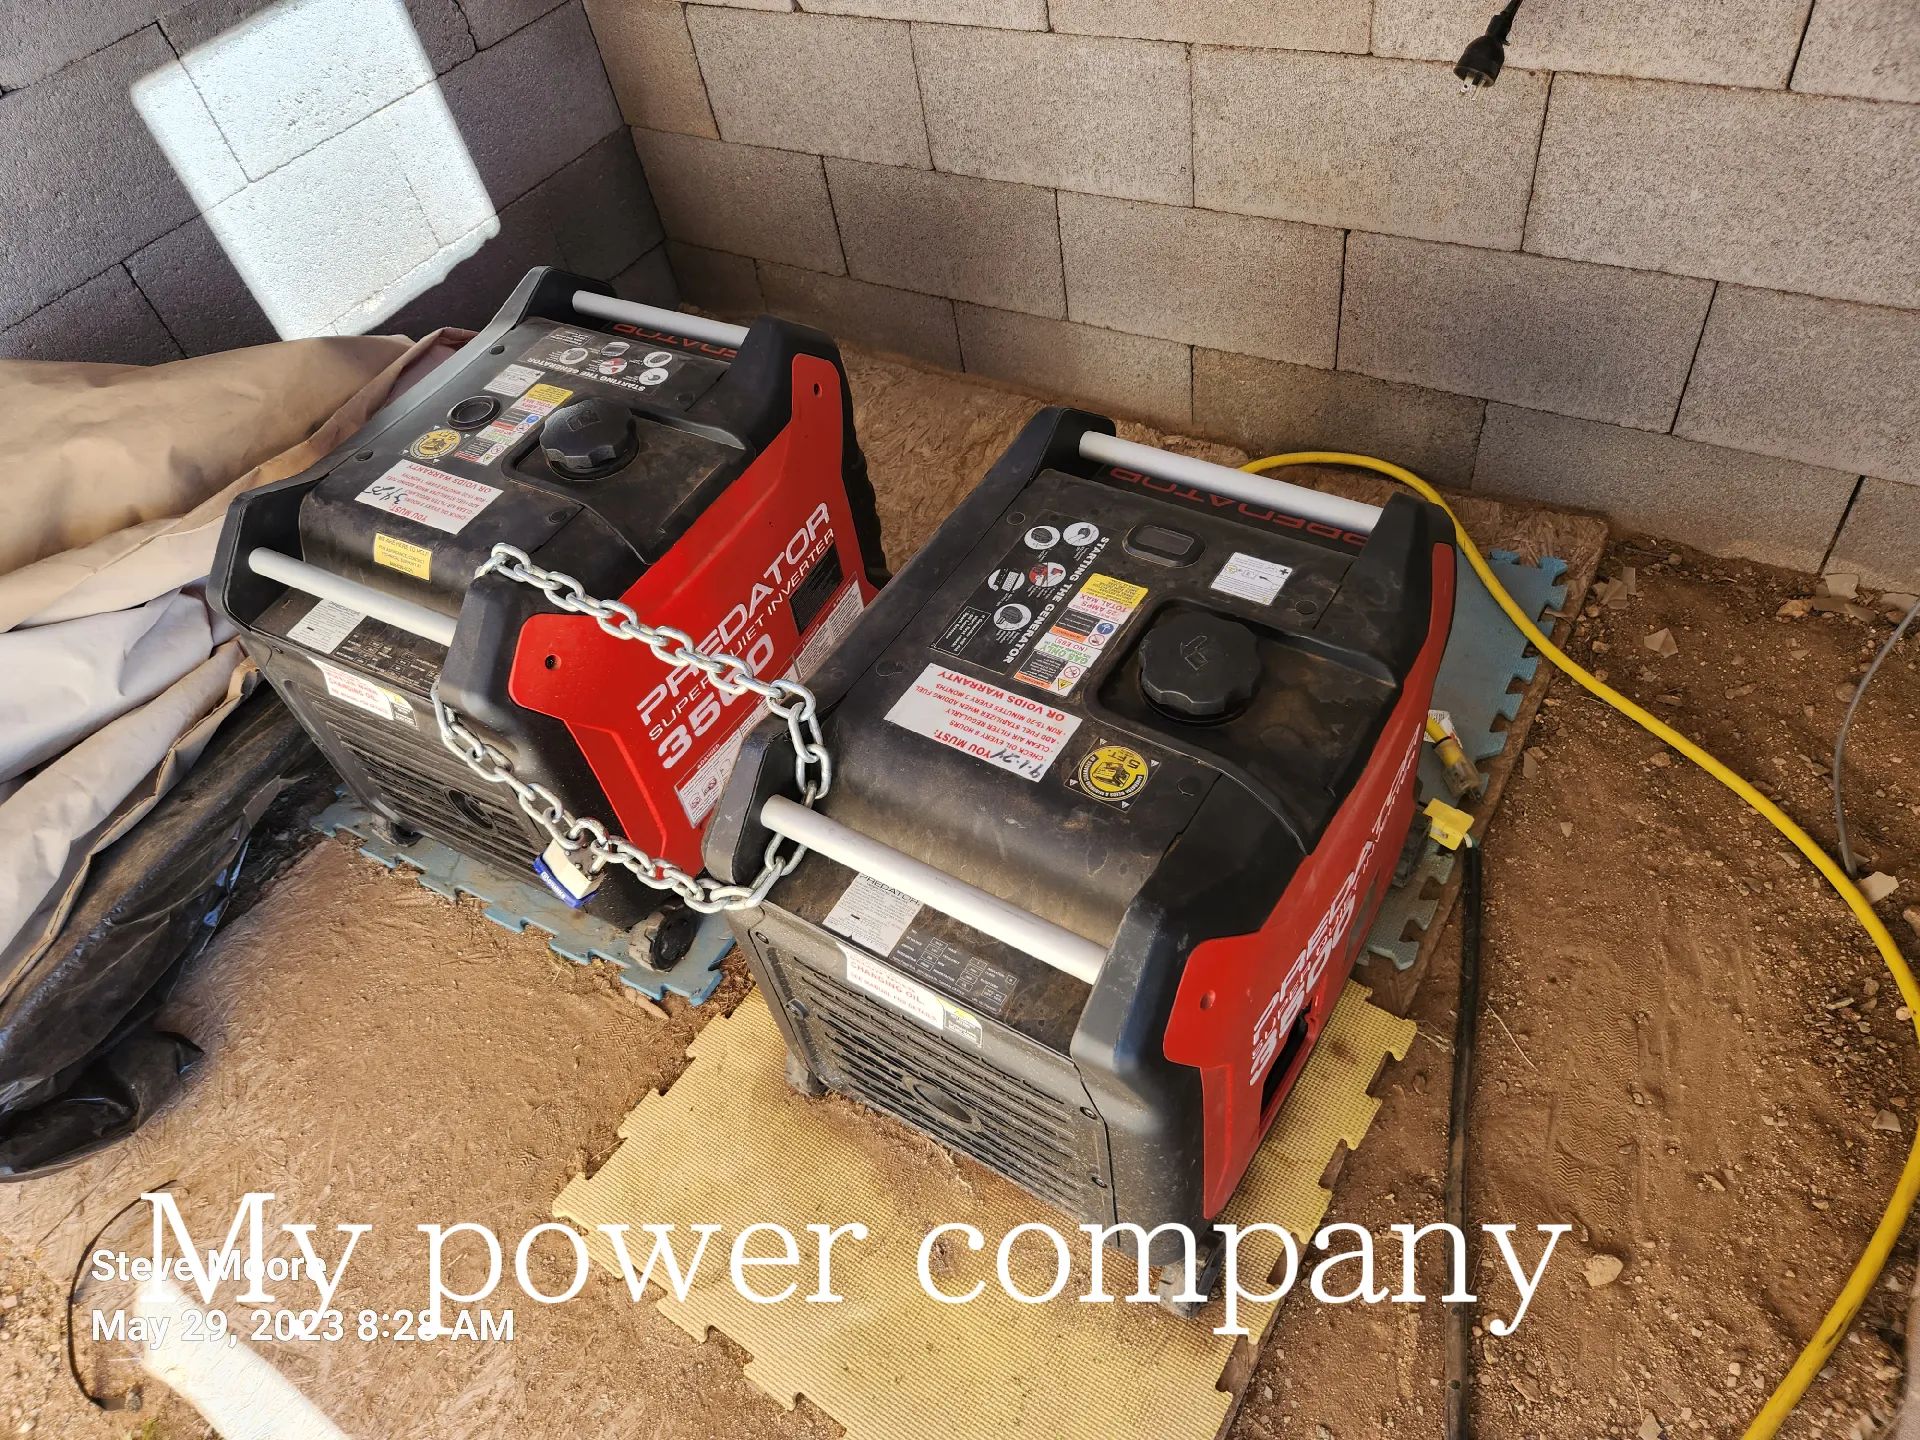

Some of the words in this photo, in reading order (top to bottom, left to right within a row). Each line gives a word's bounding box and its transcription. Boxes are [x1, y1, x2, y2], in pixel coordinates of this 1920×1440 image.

[527, 357, 578, 373] GENERATOR
[579, 370, 598, 379] THE
[599, 375, 645, 391] STARTING
[406, 464, 451, 480] WARRANTY
[451, 478, 477, 489] VOIDS
[477, 485, 491, 493] OR
[410, 512, 427, 522] YOU
[1069, 537, 1109, 580] STARTING
[1052, 583, 1072, 602] THE
[1079, 593, 1099, 603] MAX
[1081, 600, 1105, 612] AMPS
[1102, 600, 1128, 612] TOTAL
[637, 501, 831, 727] PREDATOR
[648, 677, 711, 741] SUPER
[767, 527, 835, 618] INVERTER
[1004, 603, 1054, 662] GENERATOR
[1039, 644, 1066, 657] ONLY
[1067, 653, 1088, 664] GAS
[915, 685, 932, 695] FUEL
[935, 683, 964, 697] MONTHS
[938, 671, 1003, 698] WARRANTY
[932, 692, 958, 705] ADDING
[970, 696, 993, 708] EVERY
[1006, 695, 1042, 714] VOIDS
[958, 702, 979, 713] WHEN
[994, 705, 1025, 720] MINUTES
[946, 708, 986, 727] REGULARLY
[980, 710, 1020, 729] STABILIZER
[1046, 709, 1064, 721] OR
[949, 719, 974, 732] HOURS
[986, 723, 1011, 736] FILTER
[1022, 726, 1040, 737] FUEL
[1045, 725, 1062, 735] RUN
[933, 729, 967, 747] MUST:
[980, 732, 1004, 745] EVERY
[1011, 733, 1025, 742] AIR
[1040, 734, 1056, 743] ADD
[967, 743, 990, 758] YOU
[1006, 741, 1017, 750] OIL
[1025, 739, 1049, 752] CLEAN
[699, 743, 719, 767] DANGER
[1018, 747, 1043, 760] CHECK
[1252, 722, 1421, 1046] PREDATOR
[851, 961, 902, 992] CHANGING
[1249, 894, 1356, 1087] 3500
